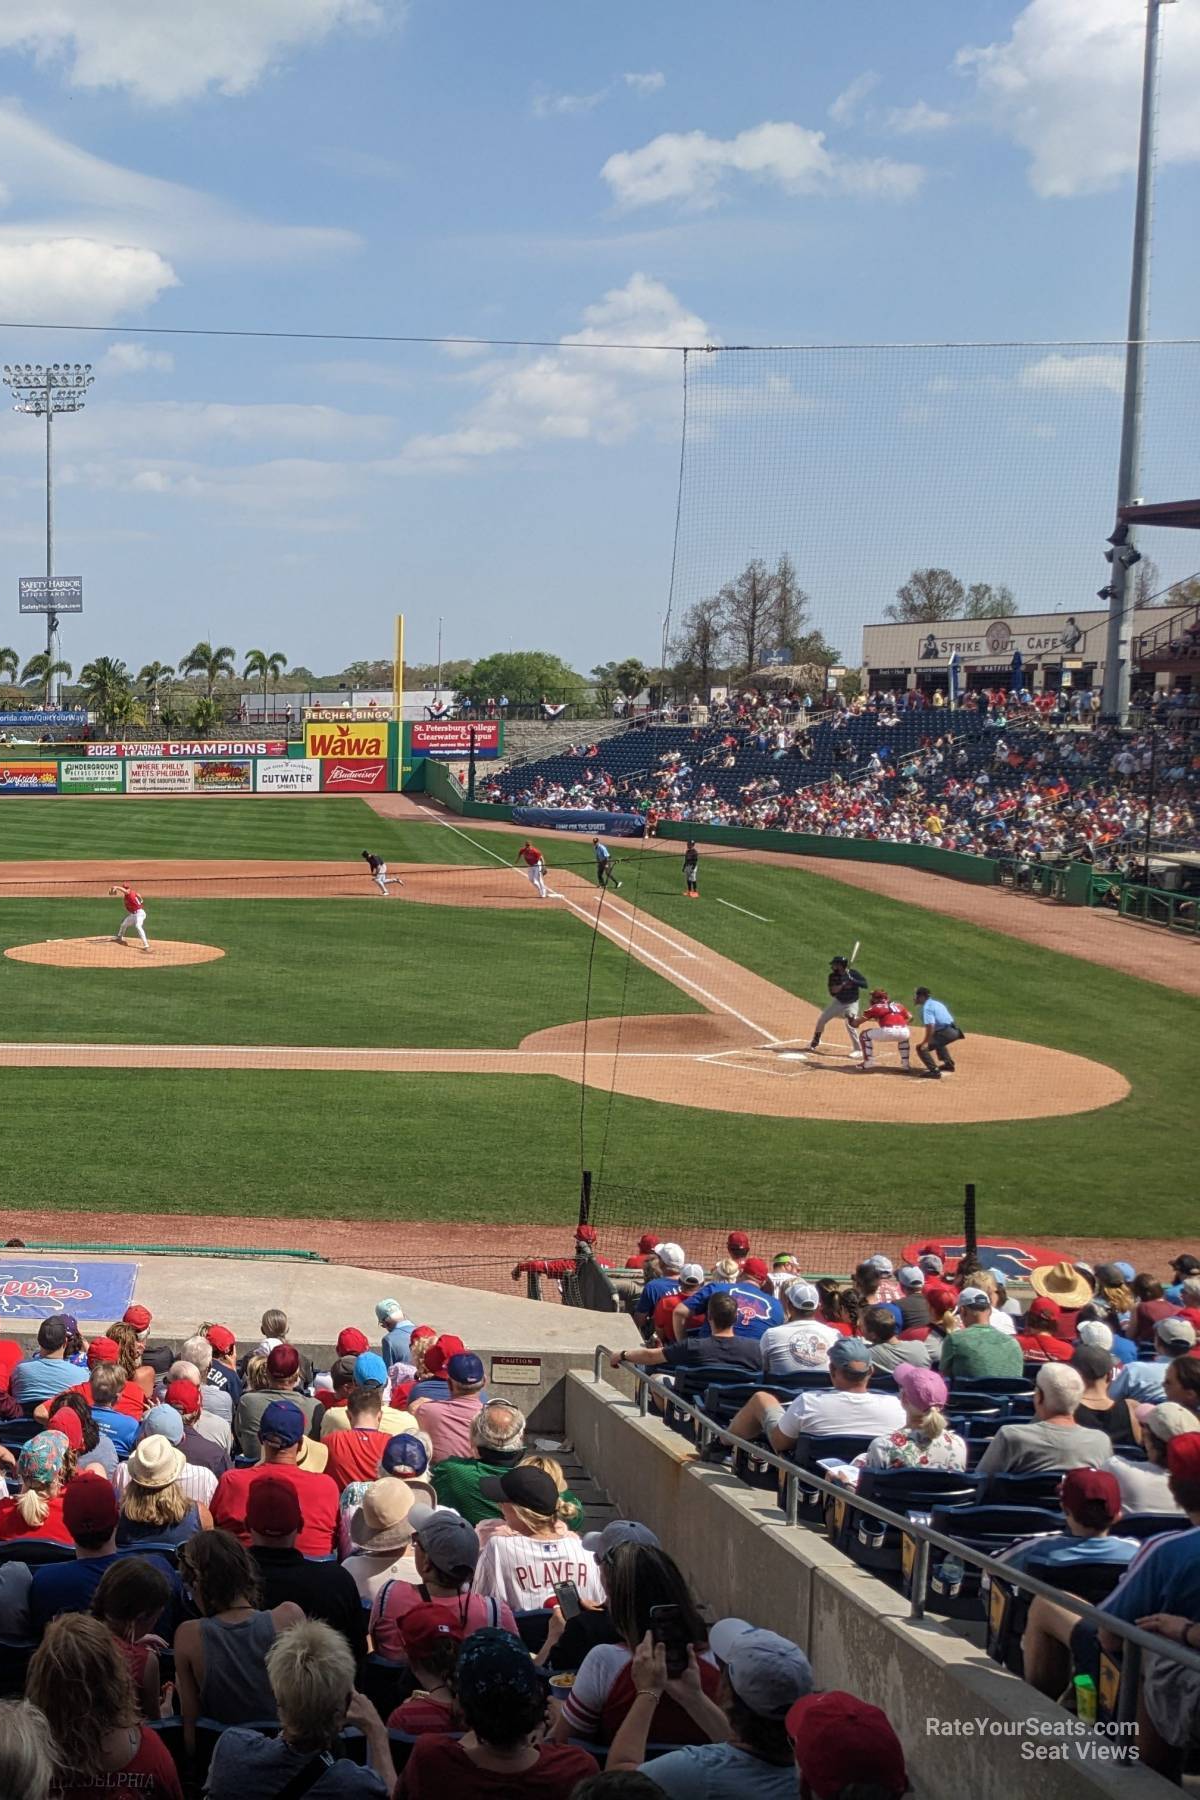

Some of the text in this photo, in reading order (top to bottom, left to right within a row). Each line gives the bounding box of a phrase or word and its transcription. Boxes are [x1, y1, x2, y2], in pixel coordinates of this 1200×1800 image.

[48, 580, 80, 588] HARBOR
[940, 637, 1058, 653] STRIKE OUT CAFE
[305, 710, 390, 720] BELCHER BINGO
[426, 724, 466, 734] Petersburg
[169, 743, 267, 755] CHAMPIONS
[310, 734, 381, 756] Wawa
[87, 745, 117, 756] 2022
[262, 774, 312, 784] CUTWATER
[332, 770, 378, 780] Budweiser
[515, 1561, 588, 1592] PLAYER
